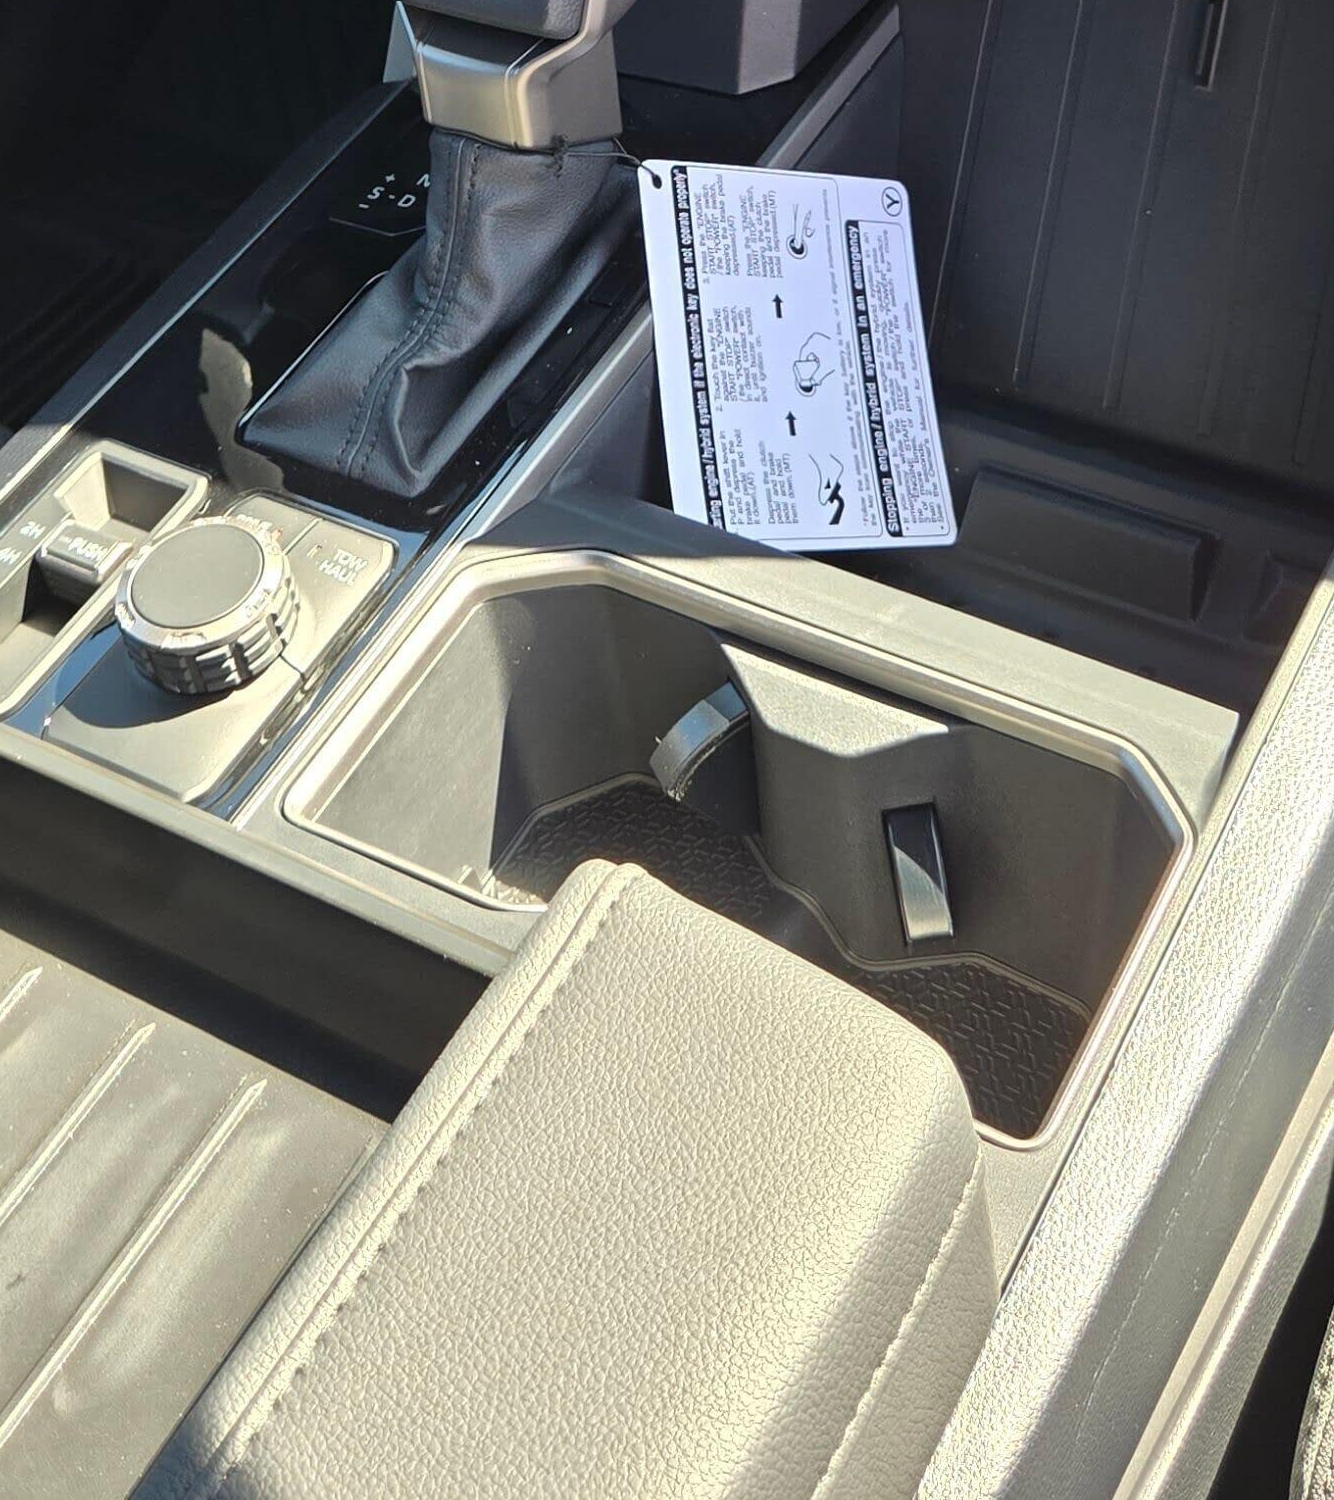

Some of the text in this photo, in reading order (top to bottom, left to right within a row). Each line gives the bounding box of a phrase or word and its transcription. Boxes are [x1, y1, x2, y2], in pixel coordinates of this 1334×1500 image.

[397, 194, 417, 208] D
[885, 193, 899, 208] Y
[678, 212, 691, 244] operate
[681, 247, 692, 263] not
[849, 225, 865, 289] emergency
[684, 266, 695, 289] does
[687, 293, 697, 310] key
[856, 295, 865, 310] an
[689, 313, 701, 358] electronic
[861, 333, 874, 376] system
[697, 390, 709, 424] system
[882, 477, 898, 531] Stopping
[20, 521, 47, 540] 2H
[334, 548, 368, 572] TOW
[318, 560, 357, 587] HAUL
